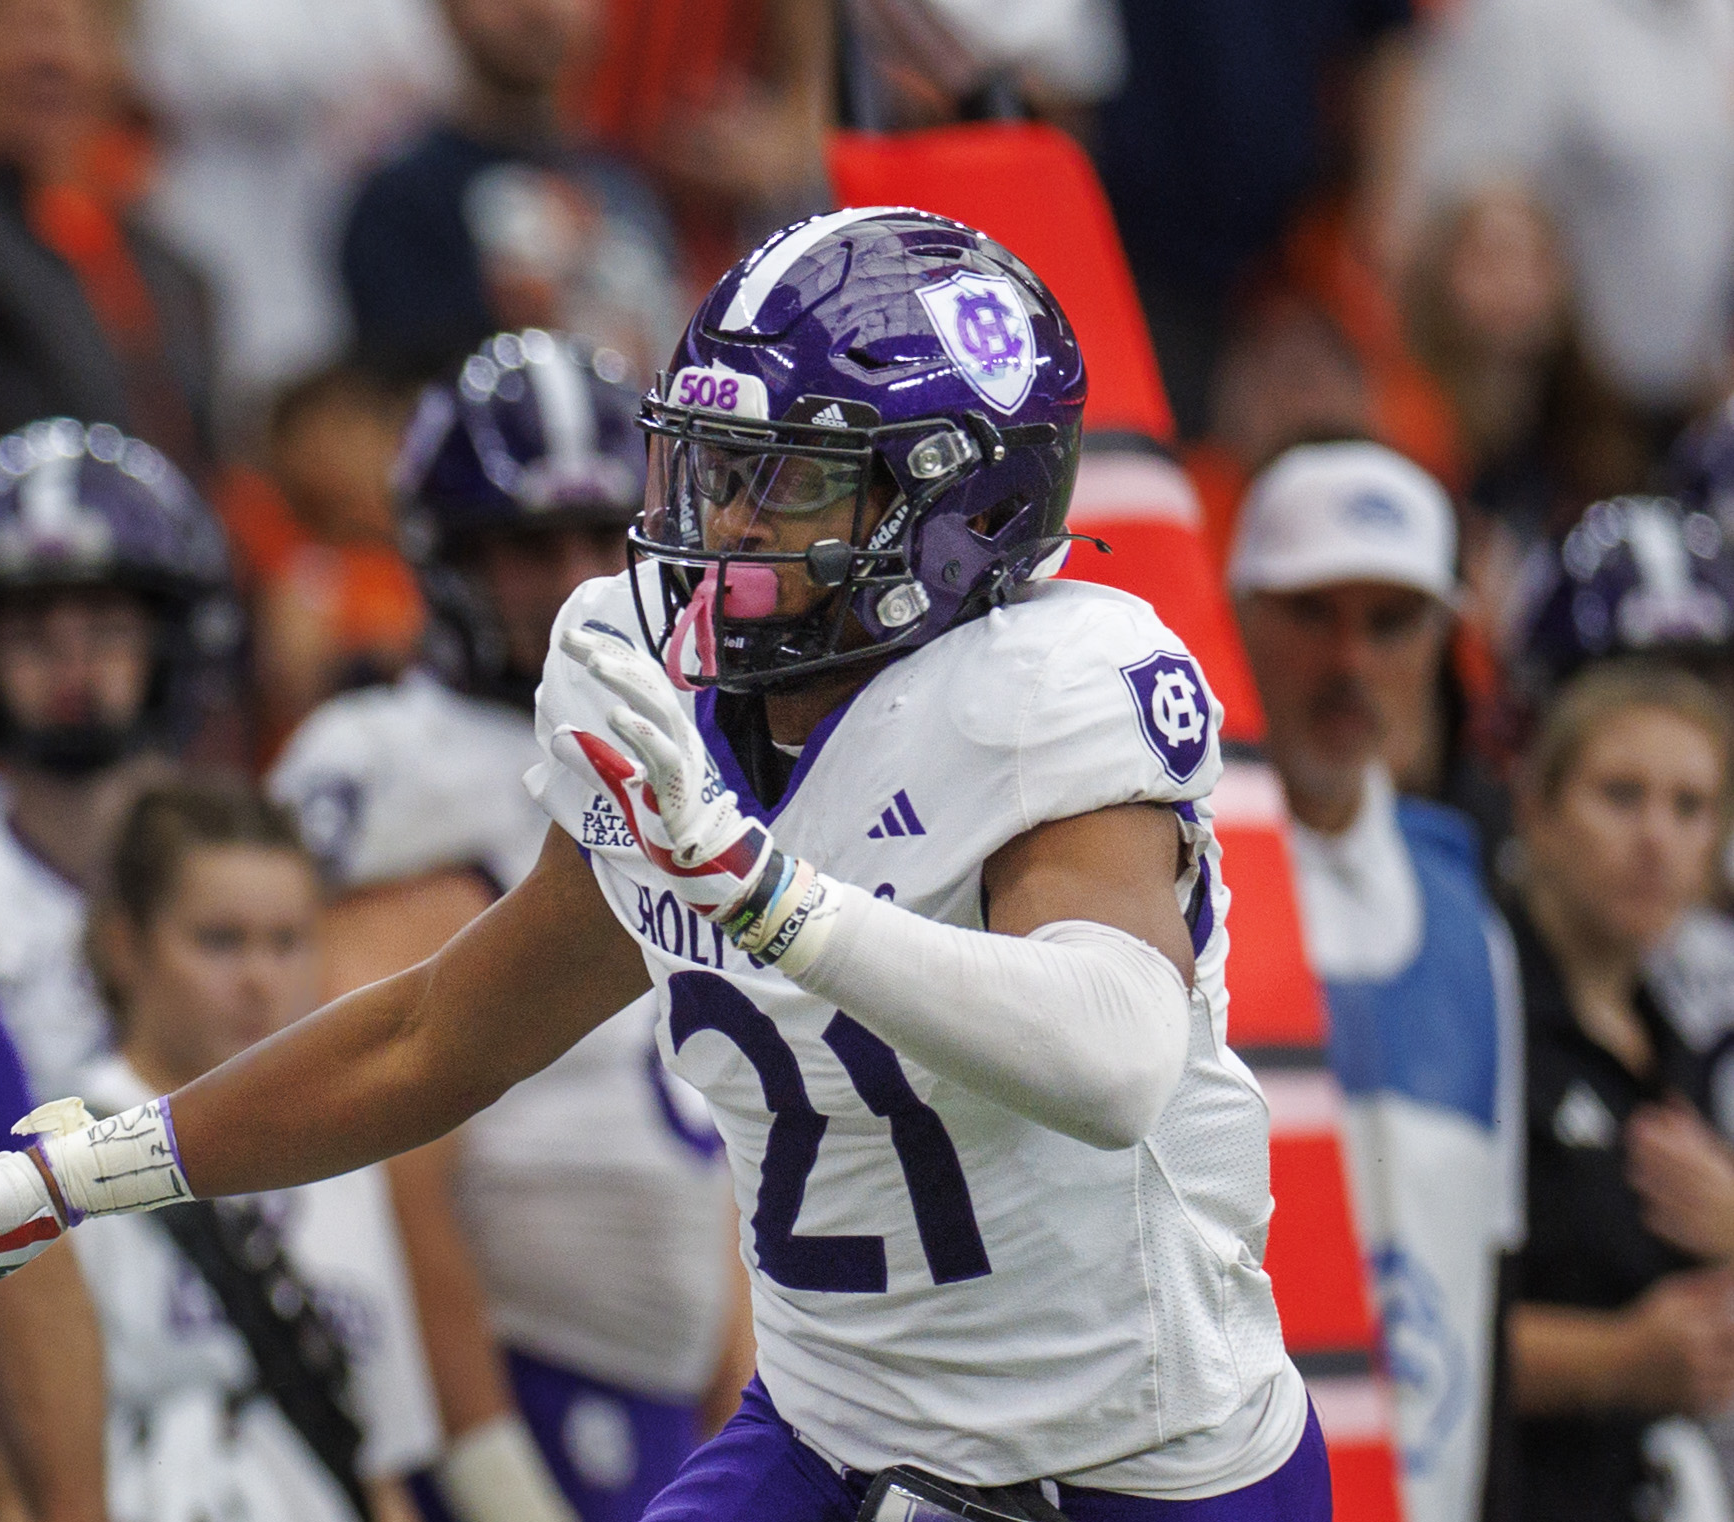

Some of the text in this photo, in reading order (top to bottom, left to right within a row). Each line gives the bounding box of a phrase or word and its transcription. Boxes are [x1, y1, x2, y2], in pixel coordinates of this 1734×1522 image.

[678, 374, 739, 410] 508
[811, 416, 849, 429] adidas
[768, 908, 805, 958] BLACK
[668, 970, 993, 1293] 21
